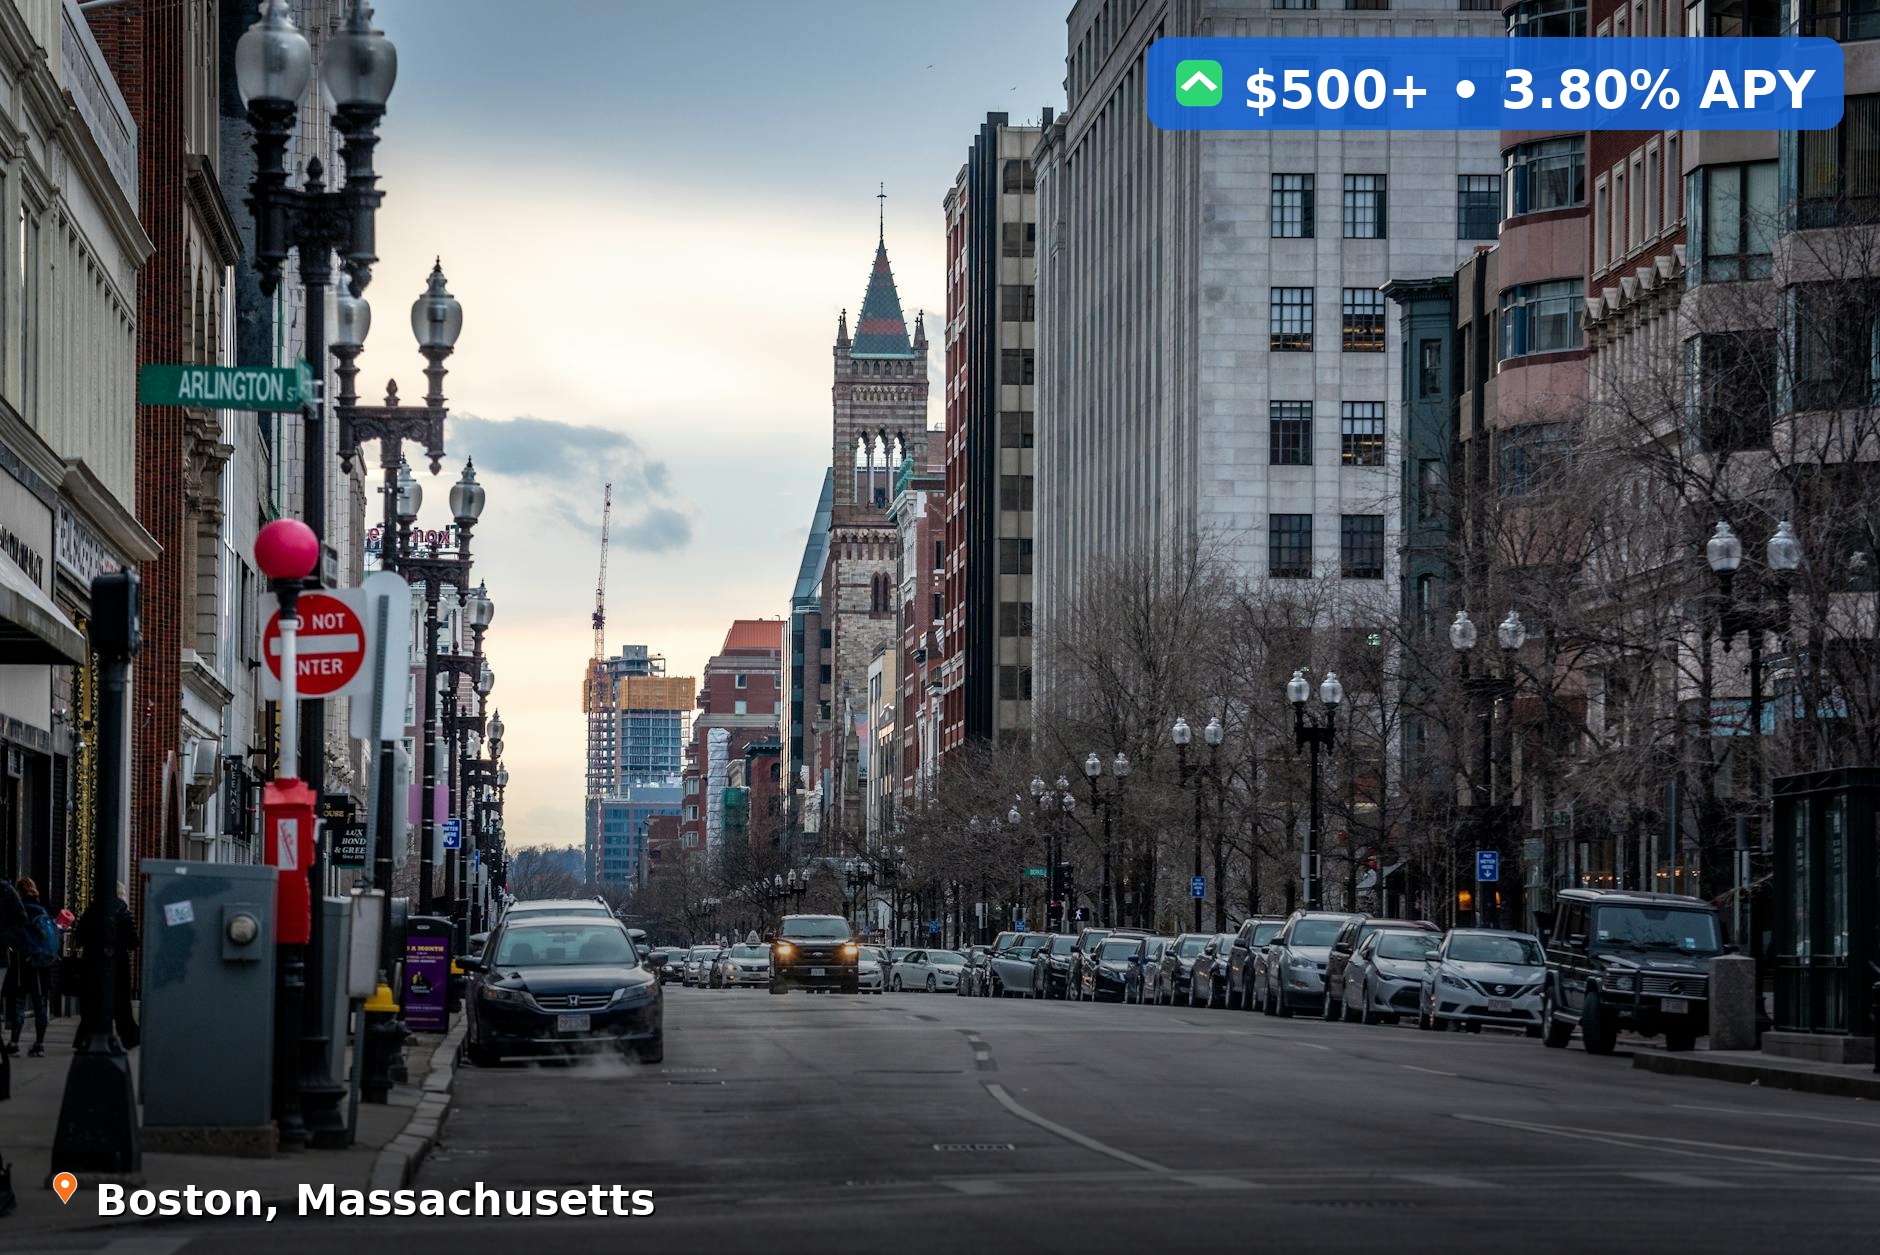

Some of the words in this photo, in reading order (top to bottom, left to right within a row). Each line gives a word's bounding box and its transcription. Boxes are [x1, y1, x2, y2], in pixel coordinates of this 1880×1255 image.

[178, 370, 284, 402] ARLINGTON
[312, 612, 345, 631] NOT
[296, 658, 344, 677] NTER
[345, 828, 364, 836] LUX
[341, 837, 367, 845] BOND
[334, 846, 341, 854] &
[342, 846, 367, 854] GREE
